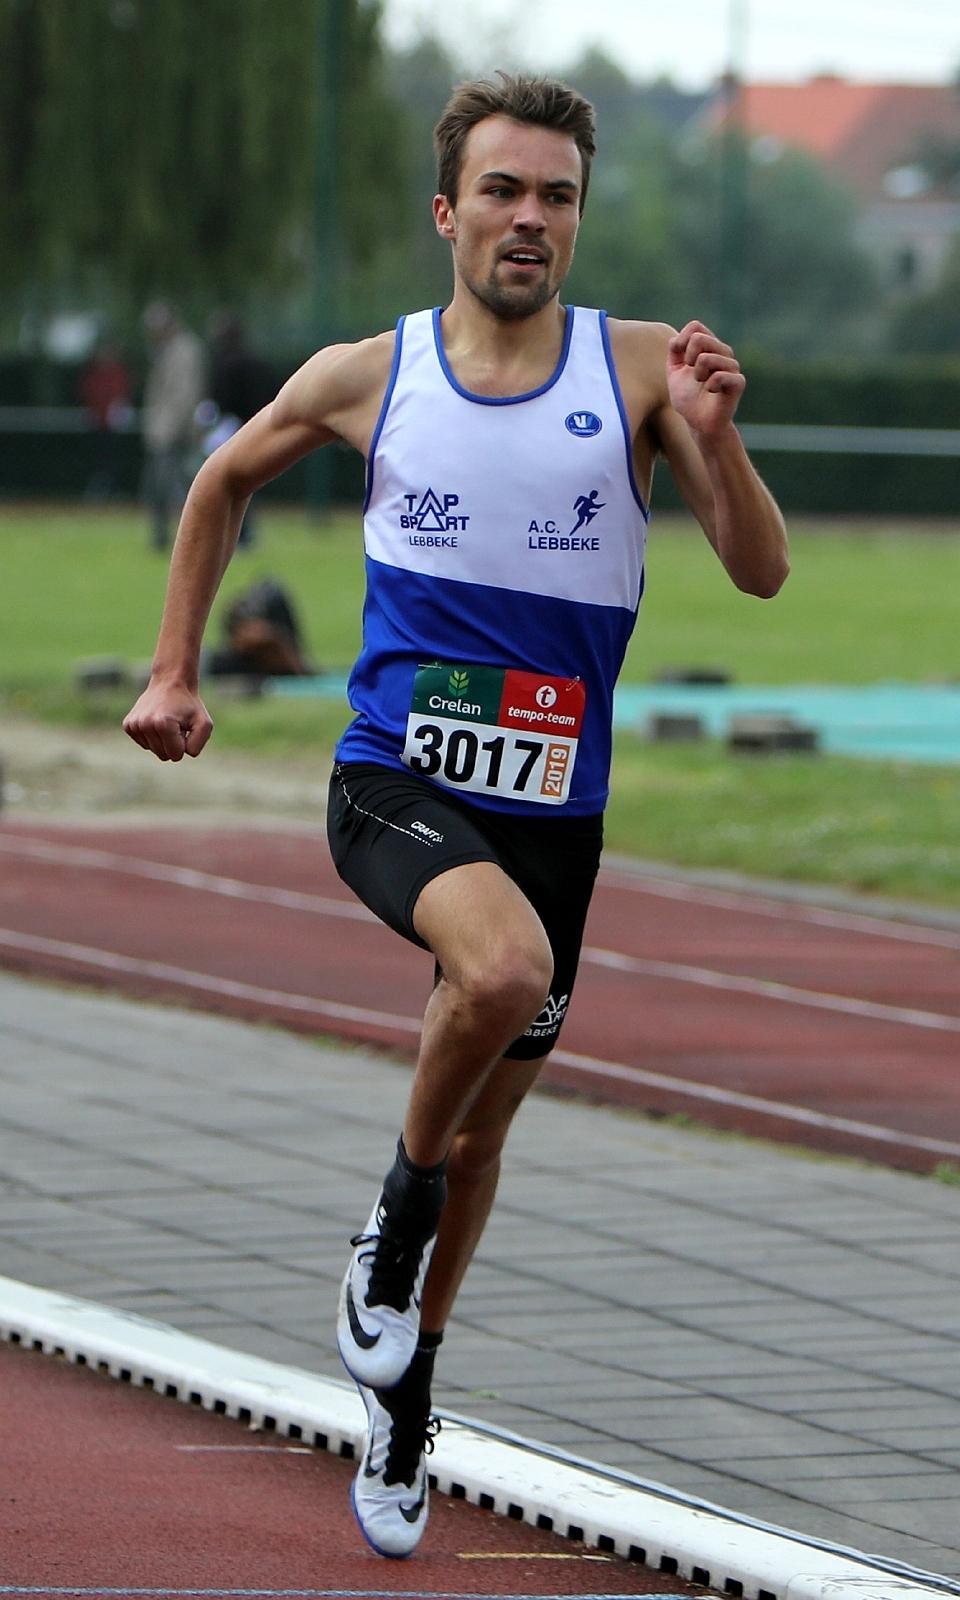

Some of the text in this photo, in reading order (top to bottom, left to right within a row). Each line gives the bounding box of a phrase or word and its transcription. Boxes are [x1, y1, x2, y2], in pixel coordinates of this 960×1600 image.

[528, 521, 560, 534] A.C.
[409, 535, 458, 548] LEBBEKE
[528, 537, 600, 551] LEBBEKE
[428, 695, 482, 716] Crelan
[508, 706, 576, 726] tempo-team
[410, 724, 544, 792] 3017
[544, 748, 568, 793] 2019
[411, 821, 441, 842] CRAFT
